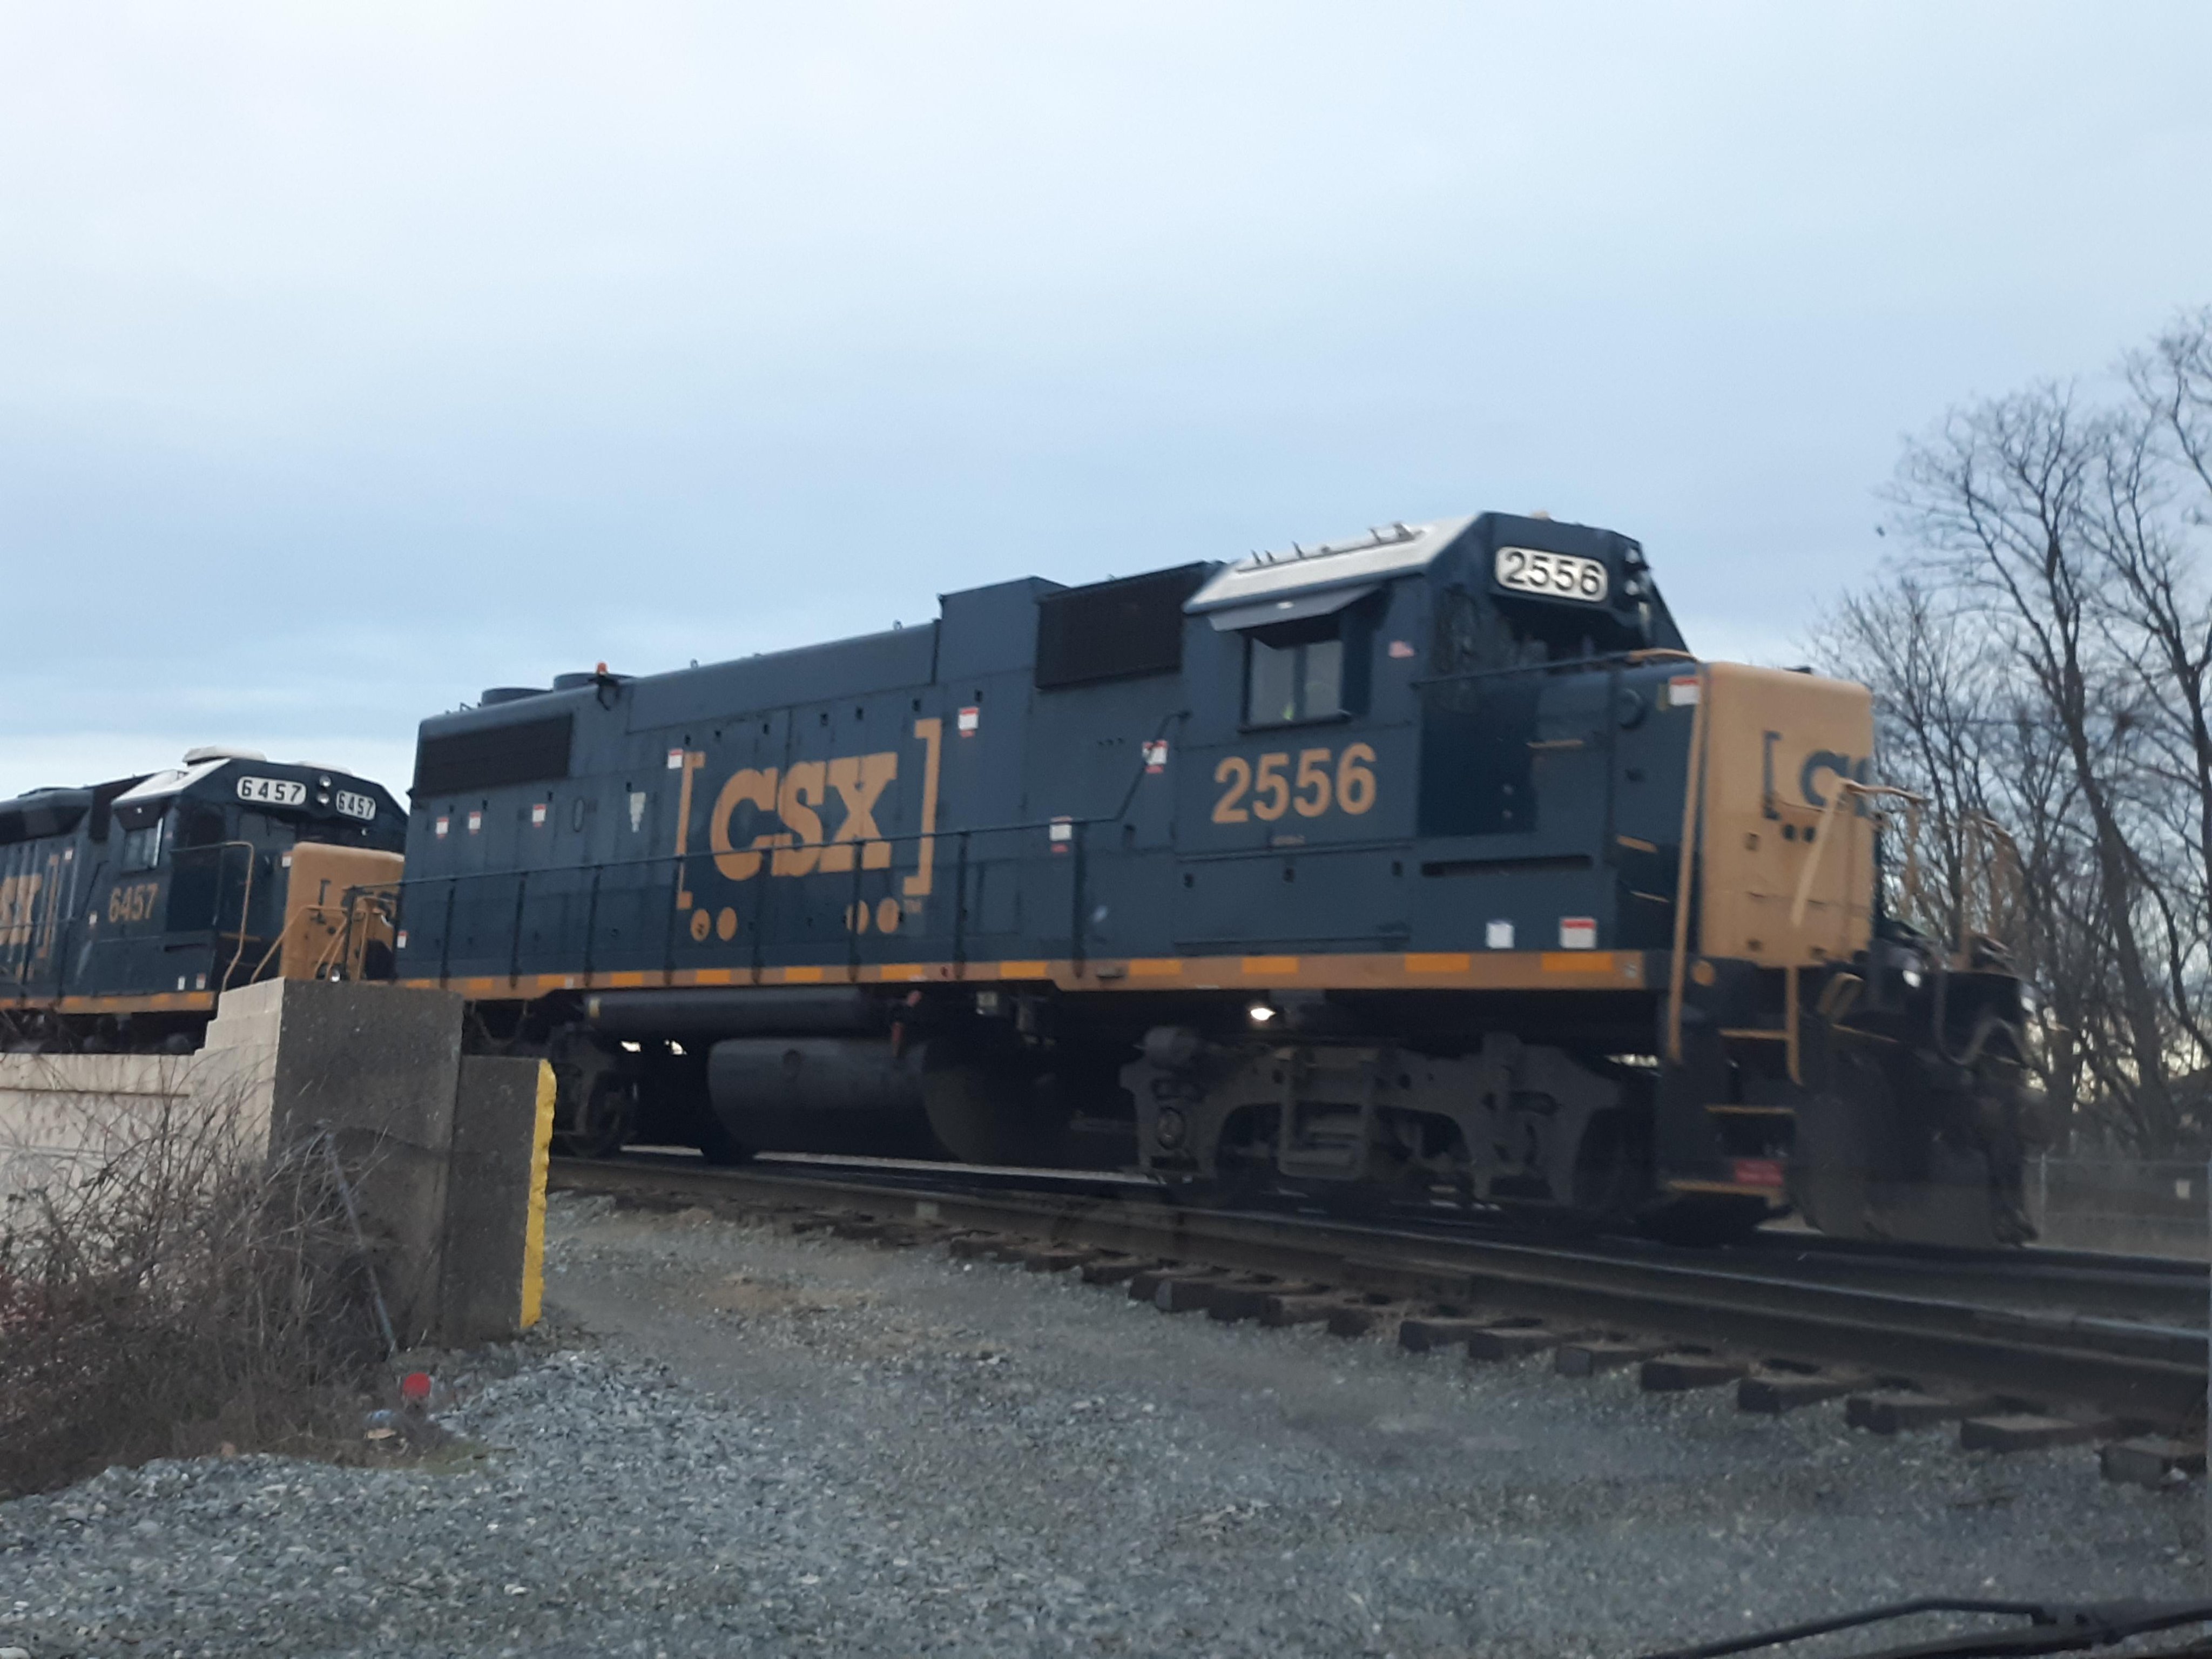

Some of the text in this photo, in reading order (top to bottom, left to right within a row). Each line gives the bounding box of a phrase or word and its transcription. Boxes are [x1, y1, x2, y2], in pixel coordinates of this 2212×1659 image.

[1505, 550, 1600, 596] 2556
[241, 779, 301, 802] 6457
[1211, 743, 1377, 824] 2556
[338, 792, 374, 818] 6457
[109, 882, 158, 923] 6457
